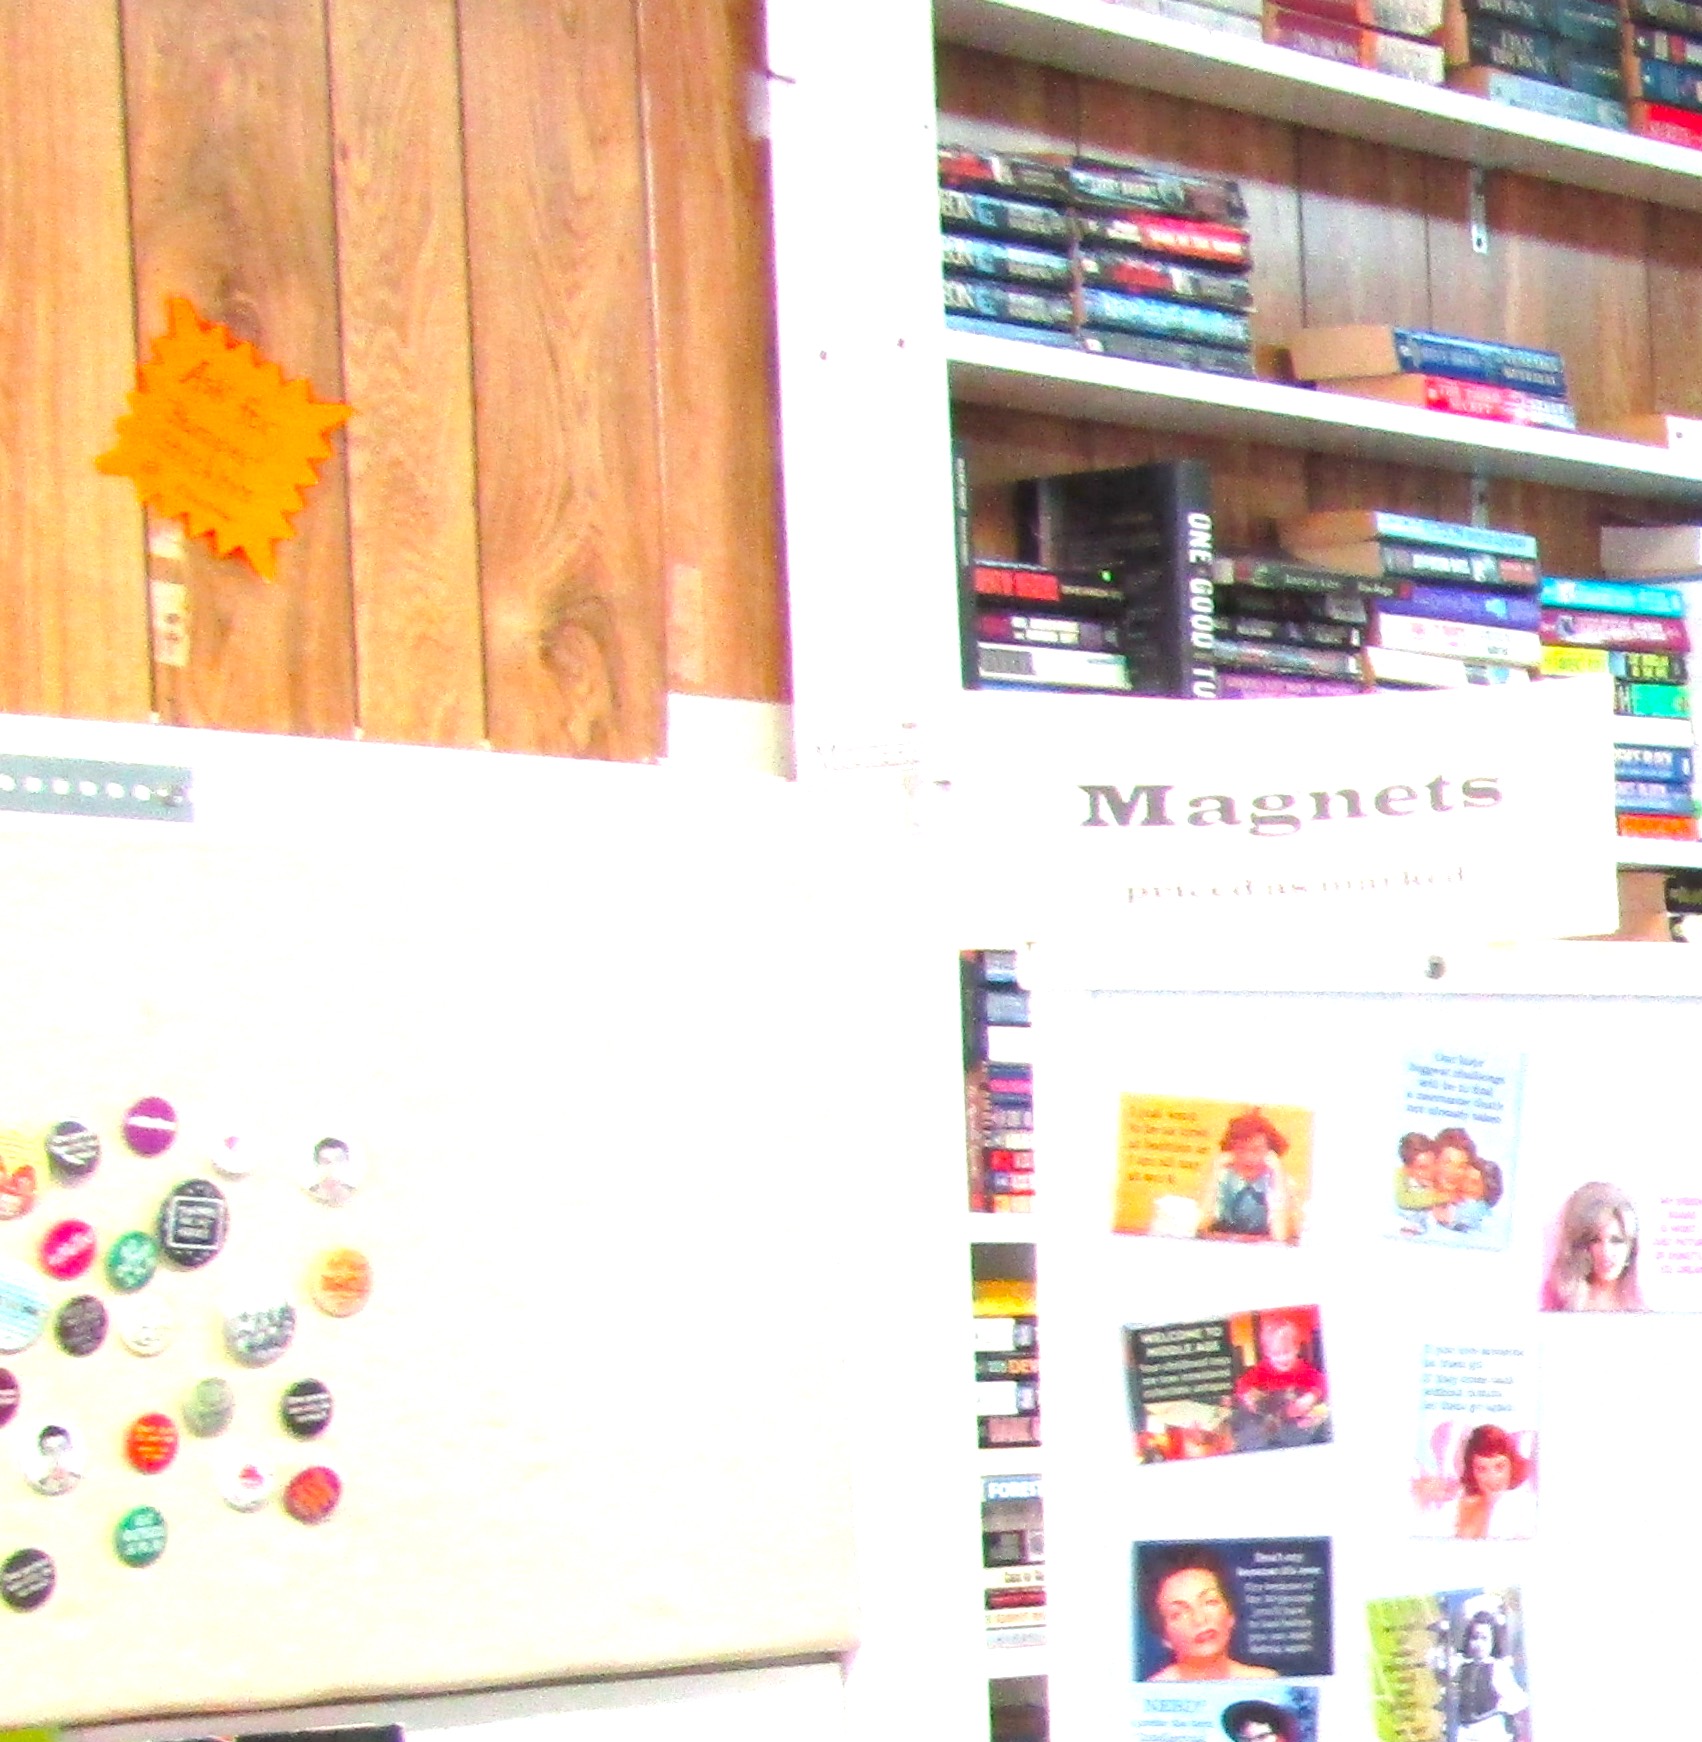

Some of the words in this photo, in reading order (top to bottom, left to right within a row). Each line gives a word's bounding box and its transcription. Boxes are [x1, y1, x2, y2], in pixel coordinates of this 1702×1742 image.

[1188, 512, 1214, 565] ONE
[1189, 578, 1216, 651] GOOD
[1078, 774, 1503, 838] Magnets
